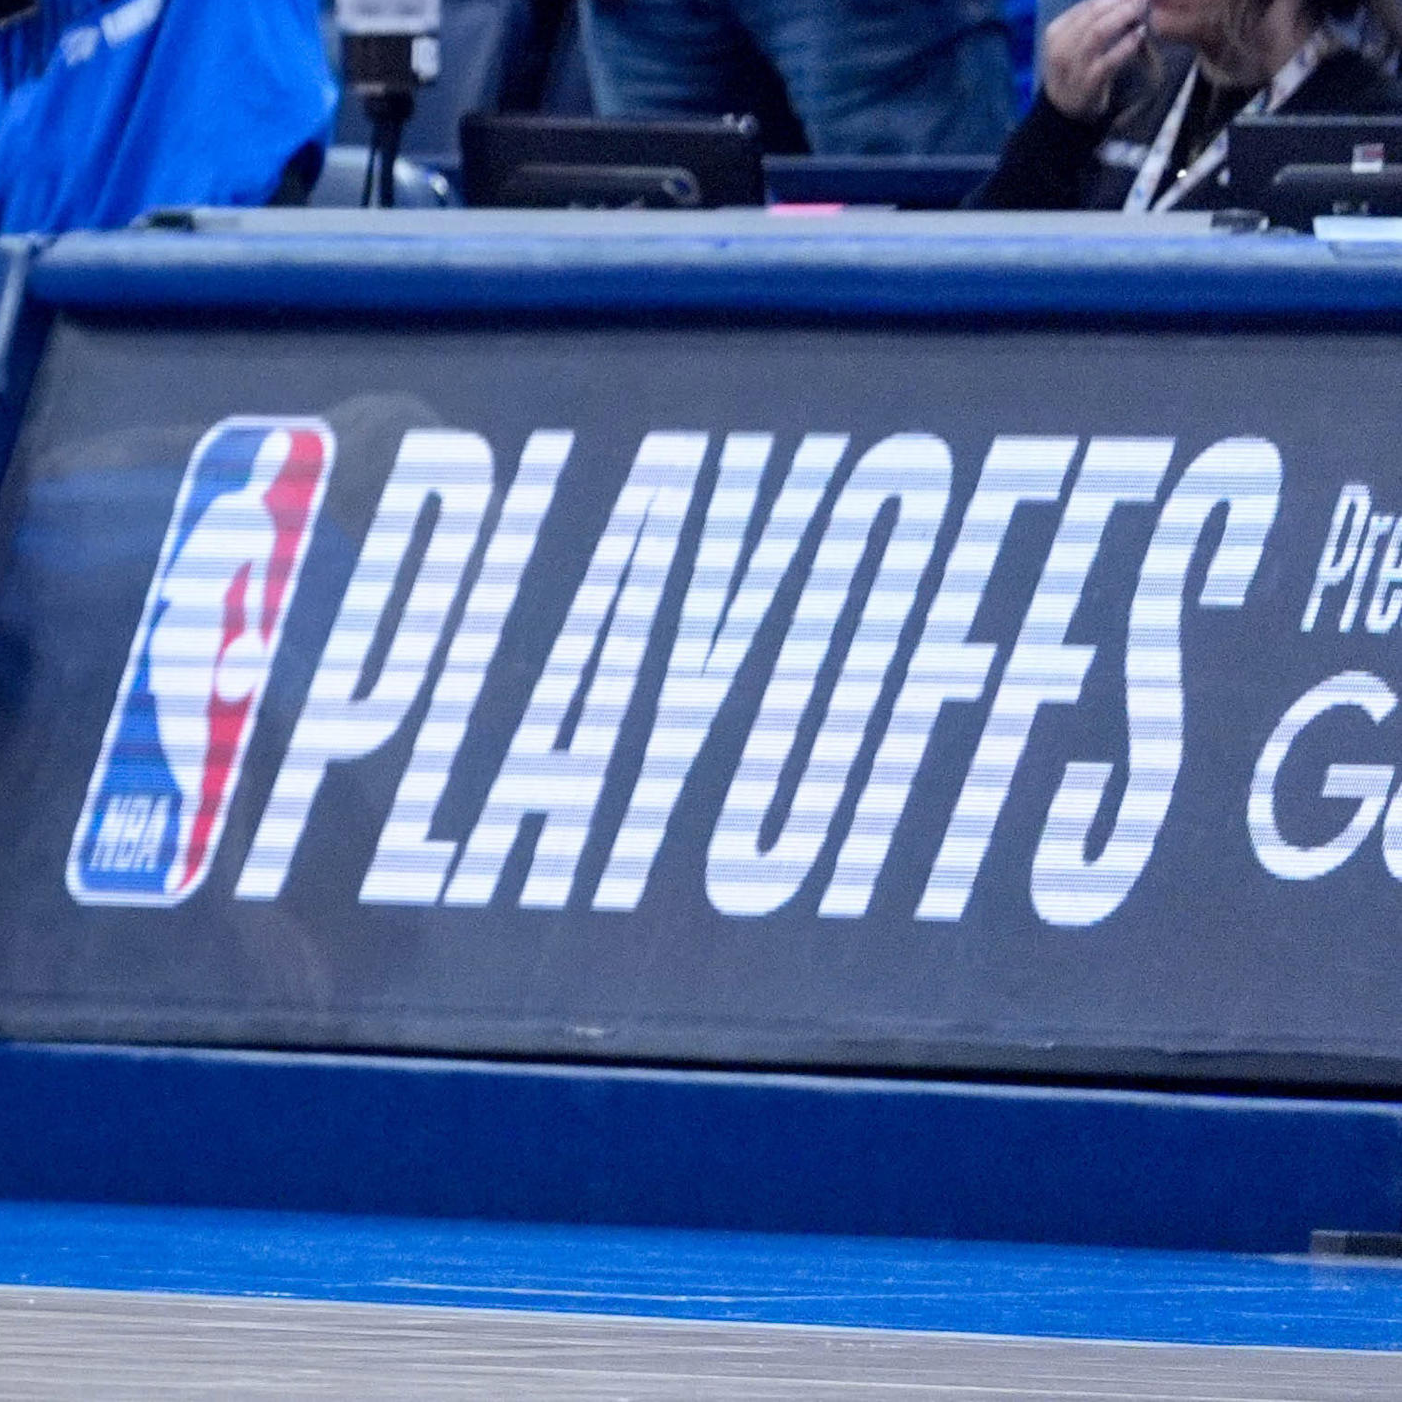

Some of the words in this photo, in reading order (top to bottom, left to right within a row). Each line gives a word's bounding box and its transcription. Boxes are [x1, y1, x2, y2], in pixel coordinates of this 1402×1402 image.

[233, 428, 1283, 927] PLAYOFFS
[1246, 669, 1402, 882] G
[88, 794, 173, 872] NBA
